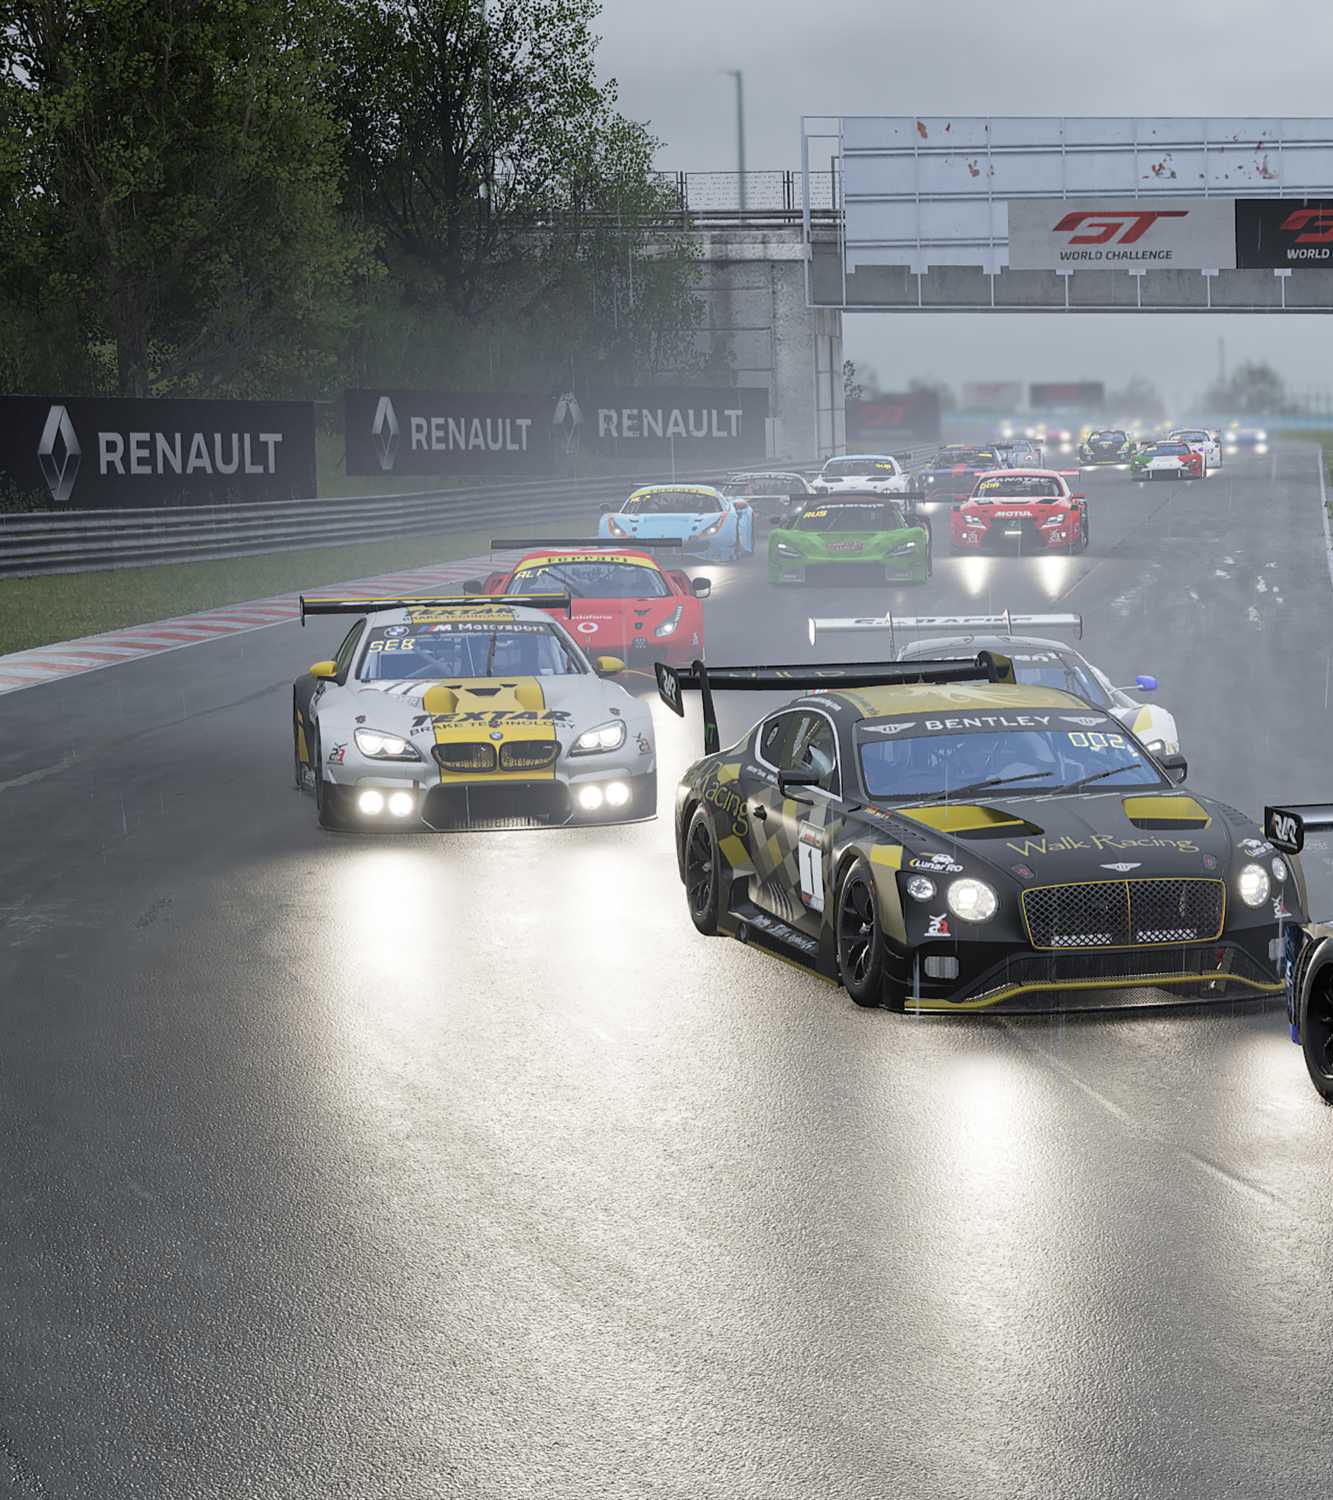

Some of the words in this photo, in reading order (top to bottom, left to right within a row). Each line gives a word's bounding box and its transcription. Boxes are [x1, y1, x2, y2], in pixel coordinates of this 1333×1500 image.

[1060, 251, 1102, 261] WORLD
[1105, 250, 1172, 260] CHALLENGE
[1287, 249, 1329, 259] WORLD
[598, 408, 743, 437] RENAULT
[410, 416, 532, 451] RENAULT
[98, 432, 283, 475] RENAULT
[994, 510, 1033, 518] MOTUL
[412, 711, 573, 727] TEXTAR
[925, 716, 1051, 731] BENTLEY
[410, 723, 464, 736] BRAKE
[1067, 731, 1126, 749] 002
[1006, 834, 1089, 857] Walk
[1090, 834, 1200, 853] Racing
